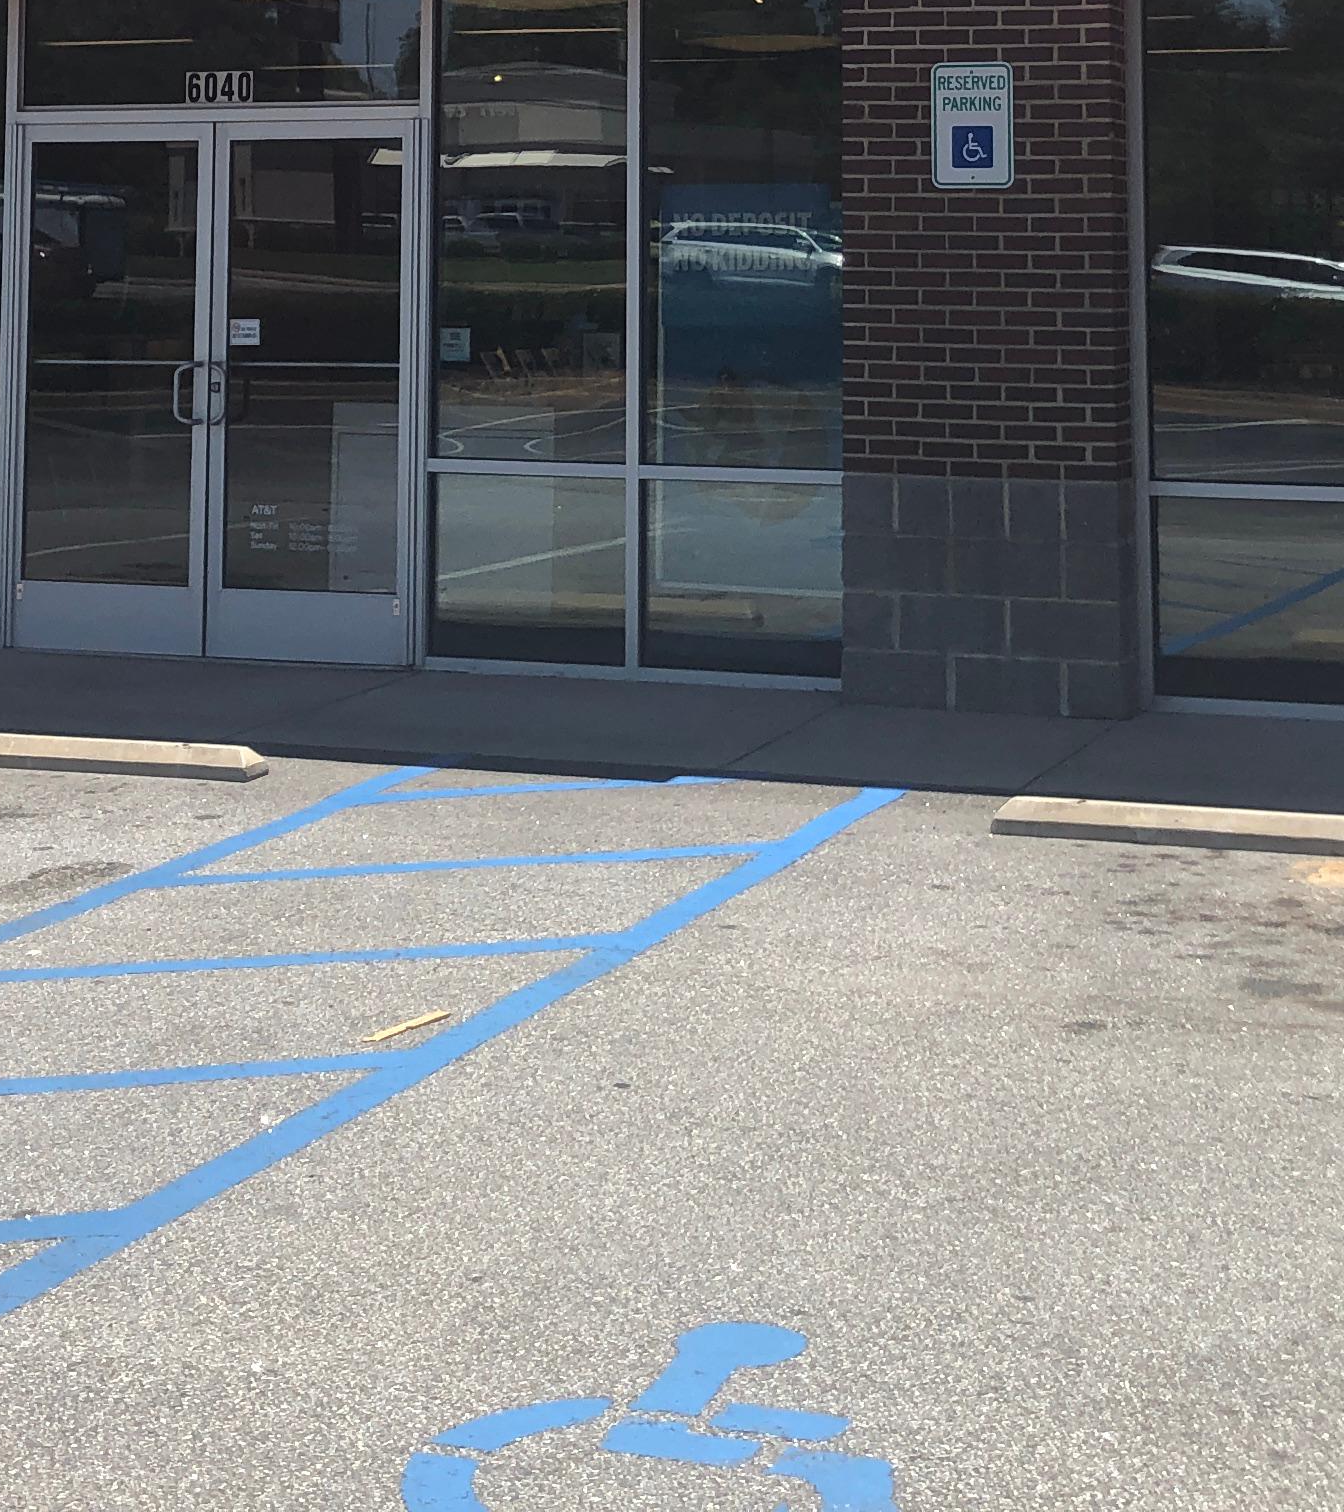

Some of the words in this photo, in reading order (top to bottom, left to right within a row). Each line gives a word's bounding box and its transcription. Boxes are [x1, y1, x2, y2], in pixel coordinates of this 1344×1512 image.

[188, 72, 251, 103] 6040
[937, 75, 1006, 91] RESERVED
[942, 96, 1002, 112] PARKING
[251, 504, 278, 516] AT&T
